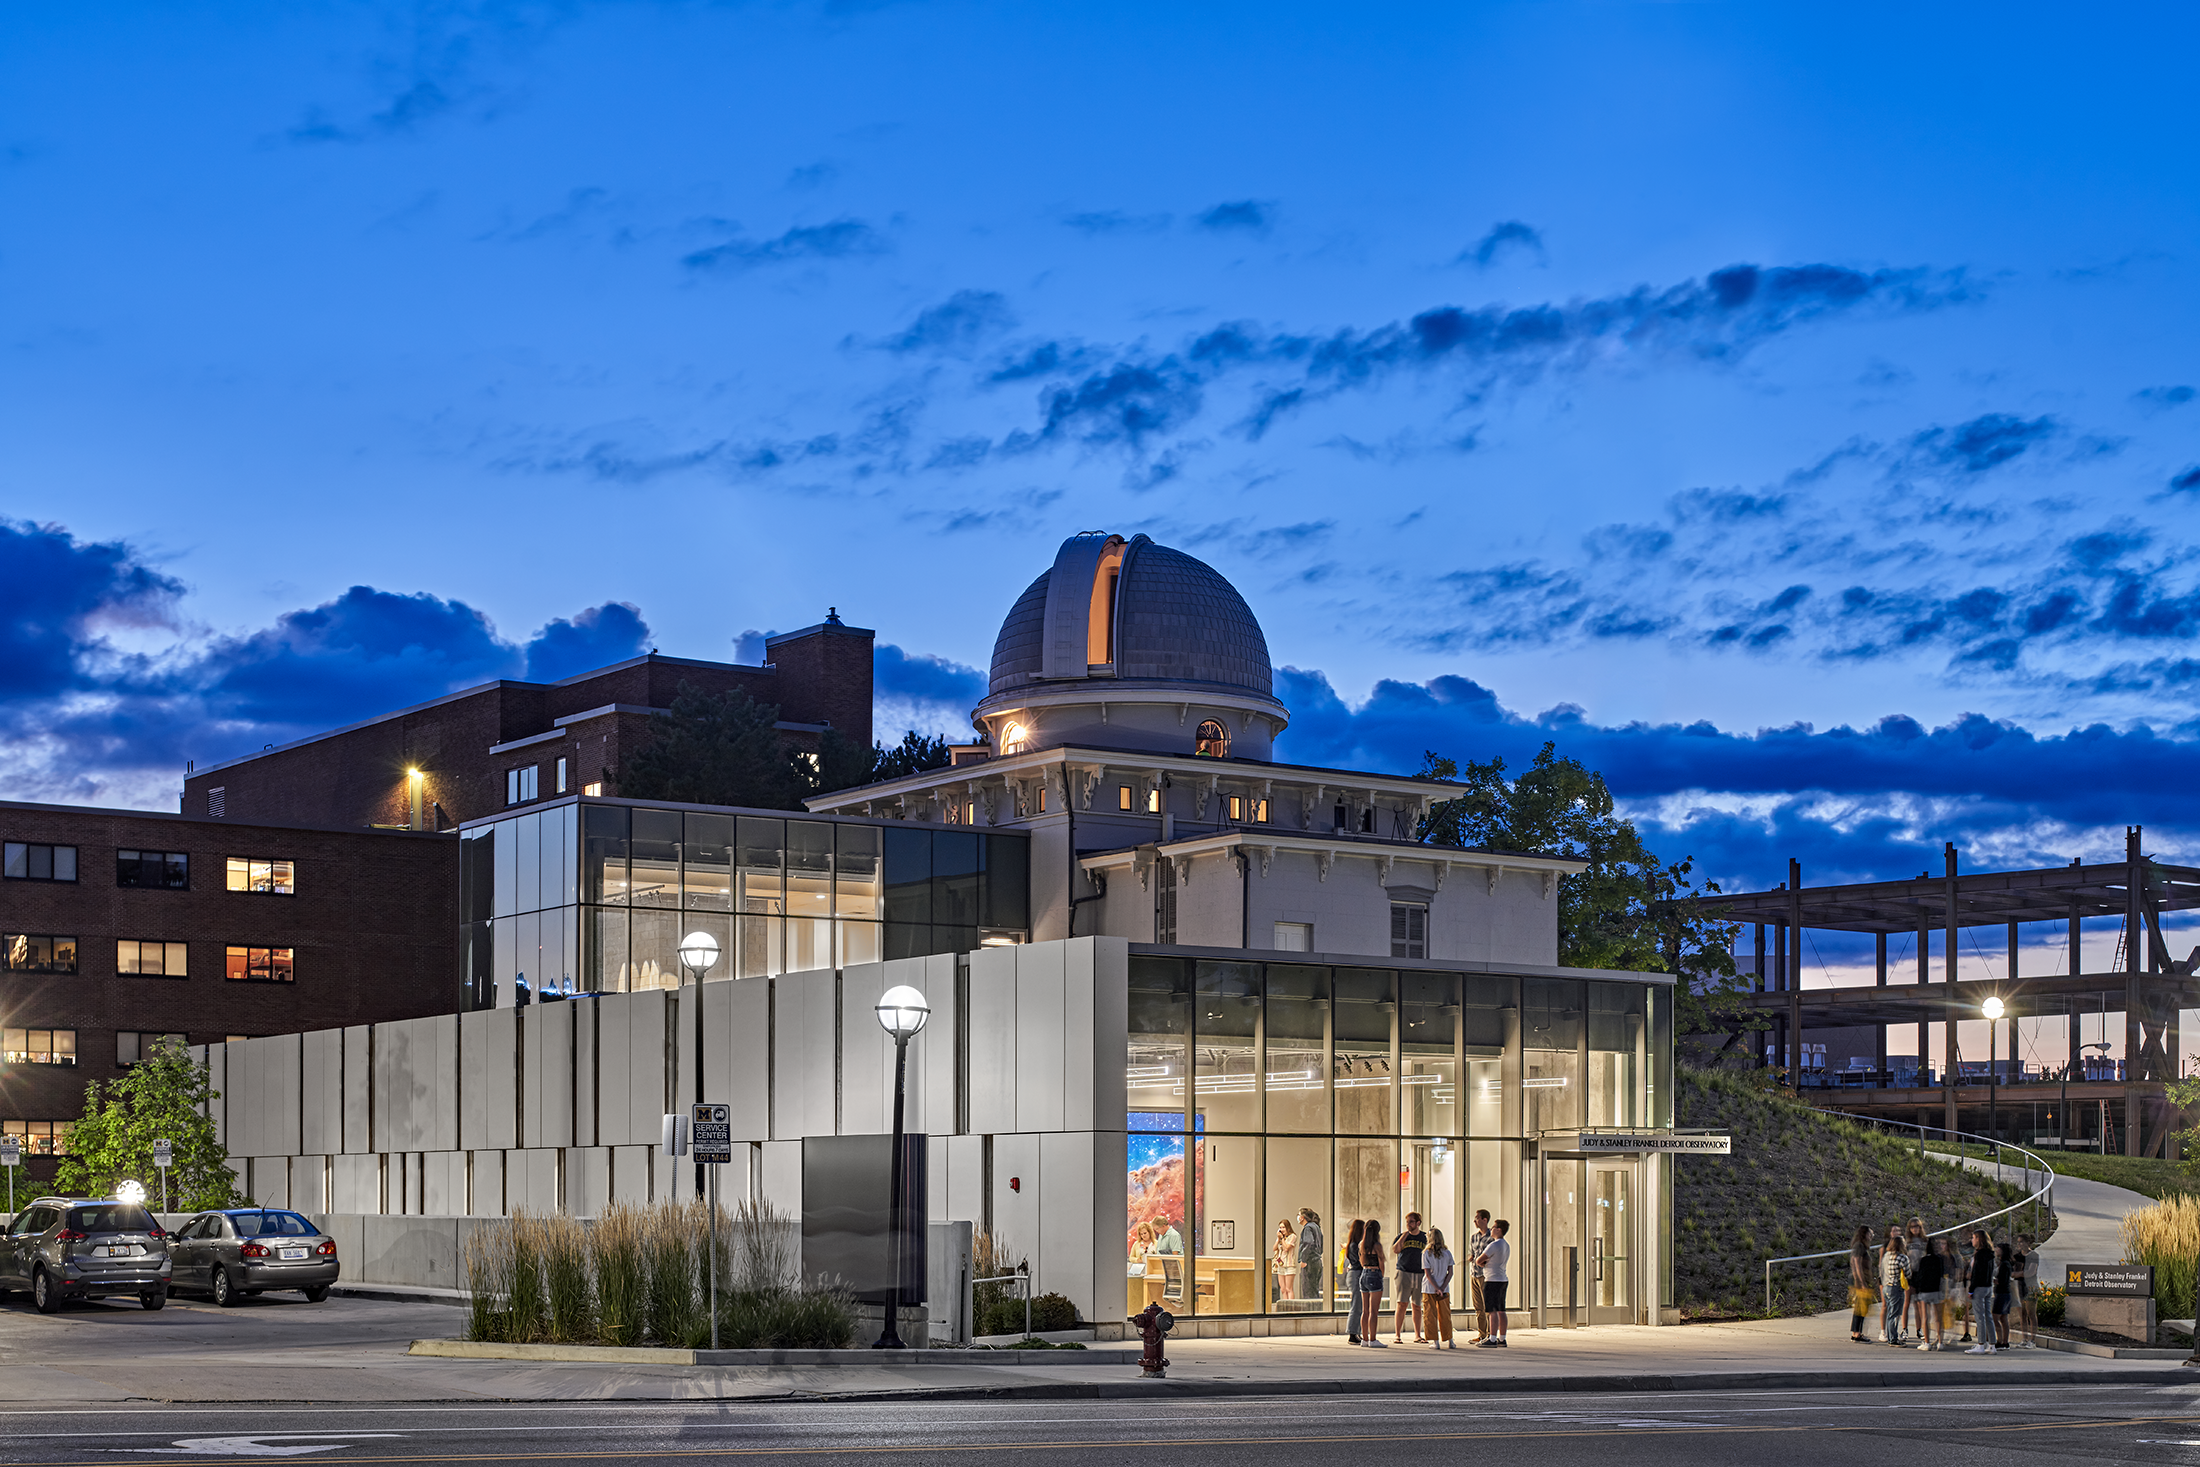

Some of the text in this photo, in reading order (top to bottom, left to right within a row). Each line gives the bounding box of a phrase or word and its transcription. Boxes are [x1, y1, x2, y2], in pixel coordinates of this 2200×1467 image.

[1582, 1138, 1598, 1146] JUDY
[1606, 1139, 1632, 1147] STANLEY
[1632, 1140, 1660, 1148] FRANKEL
[1660, 1140, 1684, 1148] DETROIT
[1686, 1140, 1728, 1148] OBSERVATORY
[2069, 1271, 2082, 1282] M
[2084, 1272, 2098, 1280] Judy
[2104, 1272, 2125, 1281] Stanley
[2104, 1281, 2137, 1289] Observatory
